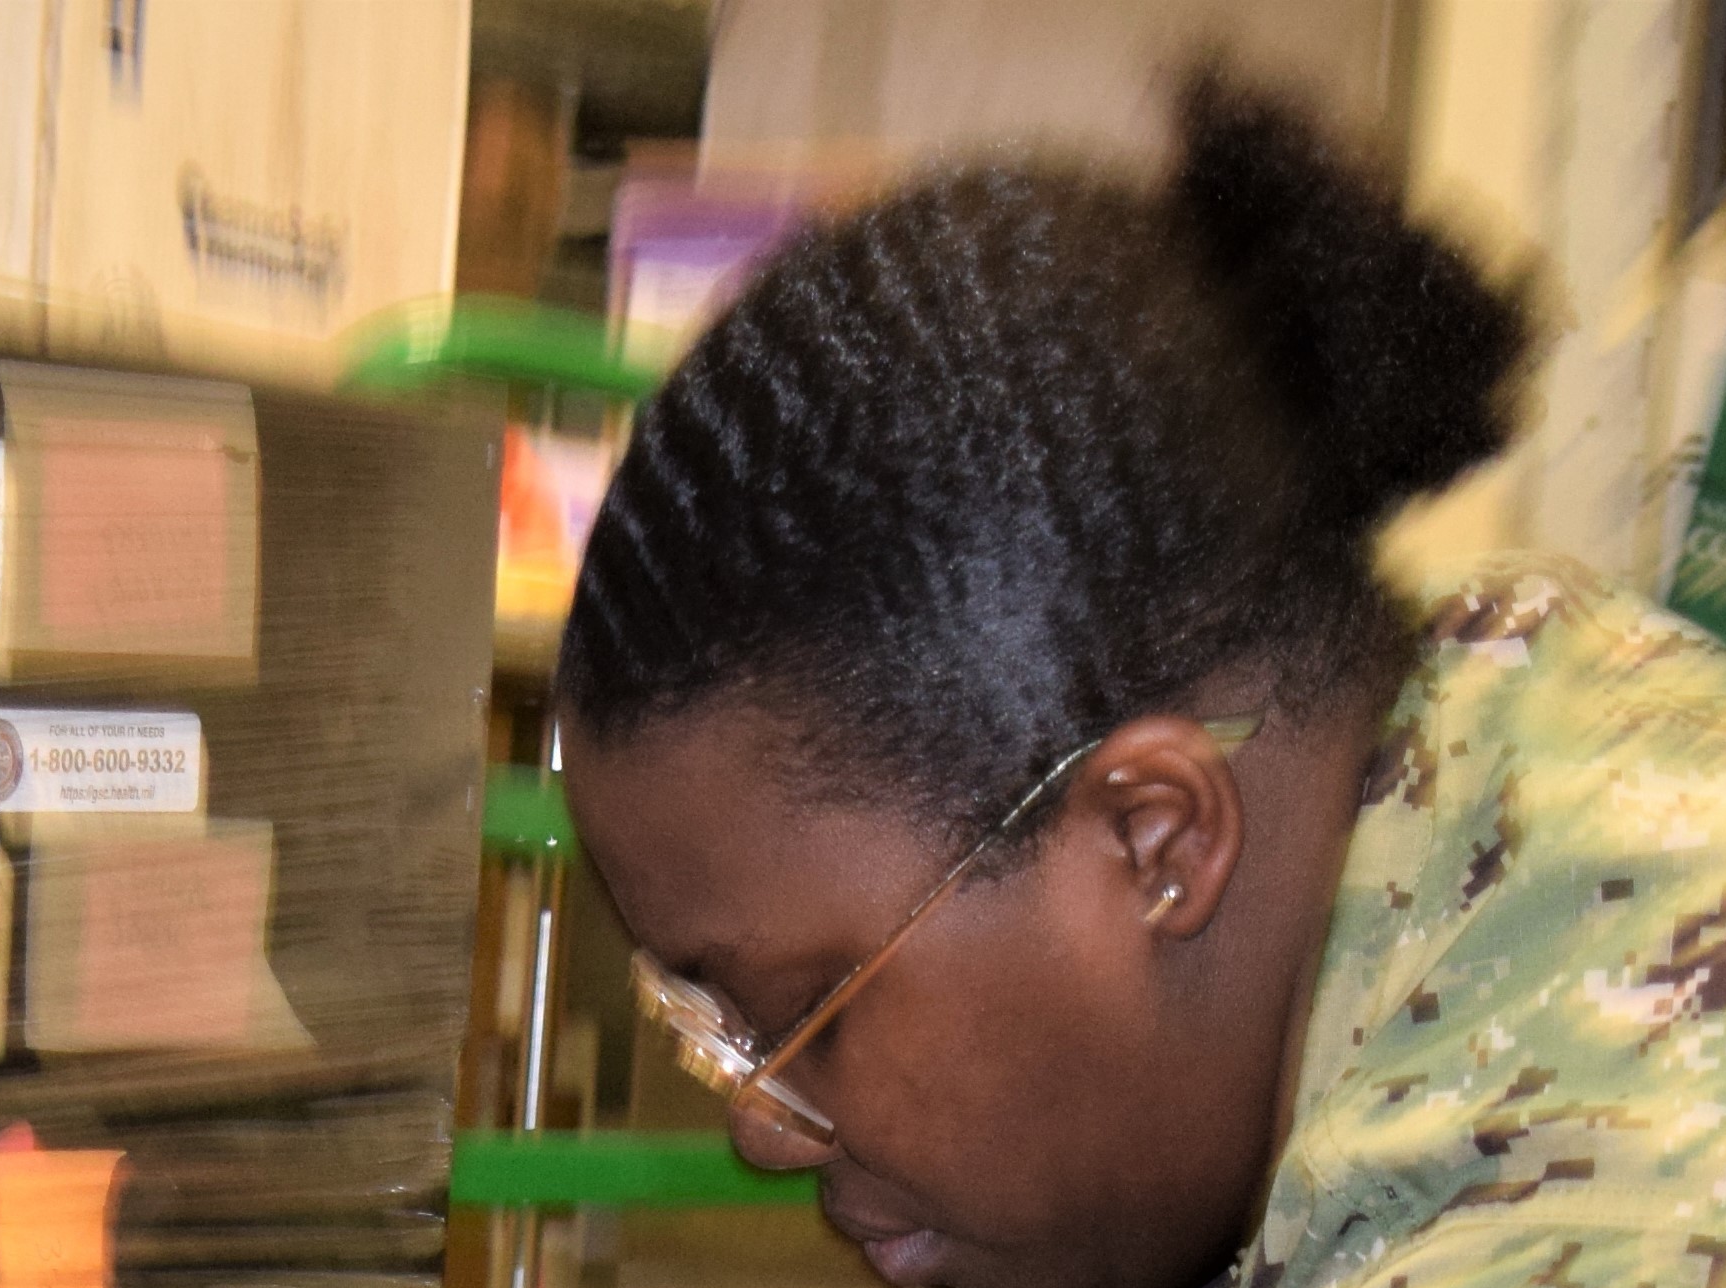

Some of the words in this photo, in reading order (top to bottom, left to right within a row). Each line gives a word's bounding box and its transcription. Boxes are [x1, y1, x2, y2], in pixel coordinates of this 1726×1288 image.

[49, 725, 68, 736] FOR
[70, 726, 85, 736] ALL
[88, 726, 100, 737] OF
[102, 725, 125, 737] YOUR
[128, 726, 135, 737] IT
[138, 727, 165, 738] NEEDS
[29, 748, 186, 774] 1-800-600-9332
[59, 785, 156, 803] https://gsc.health.mil
